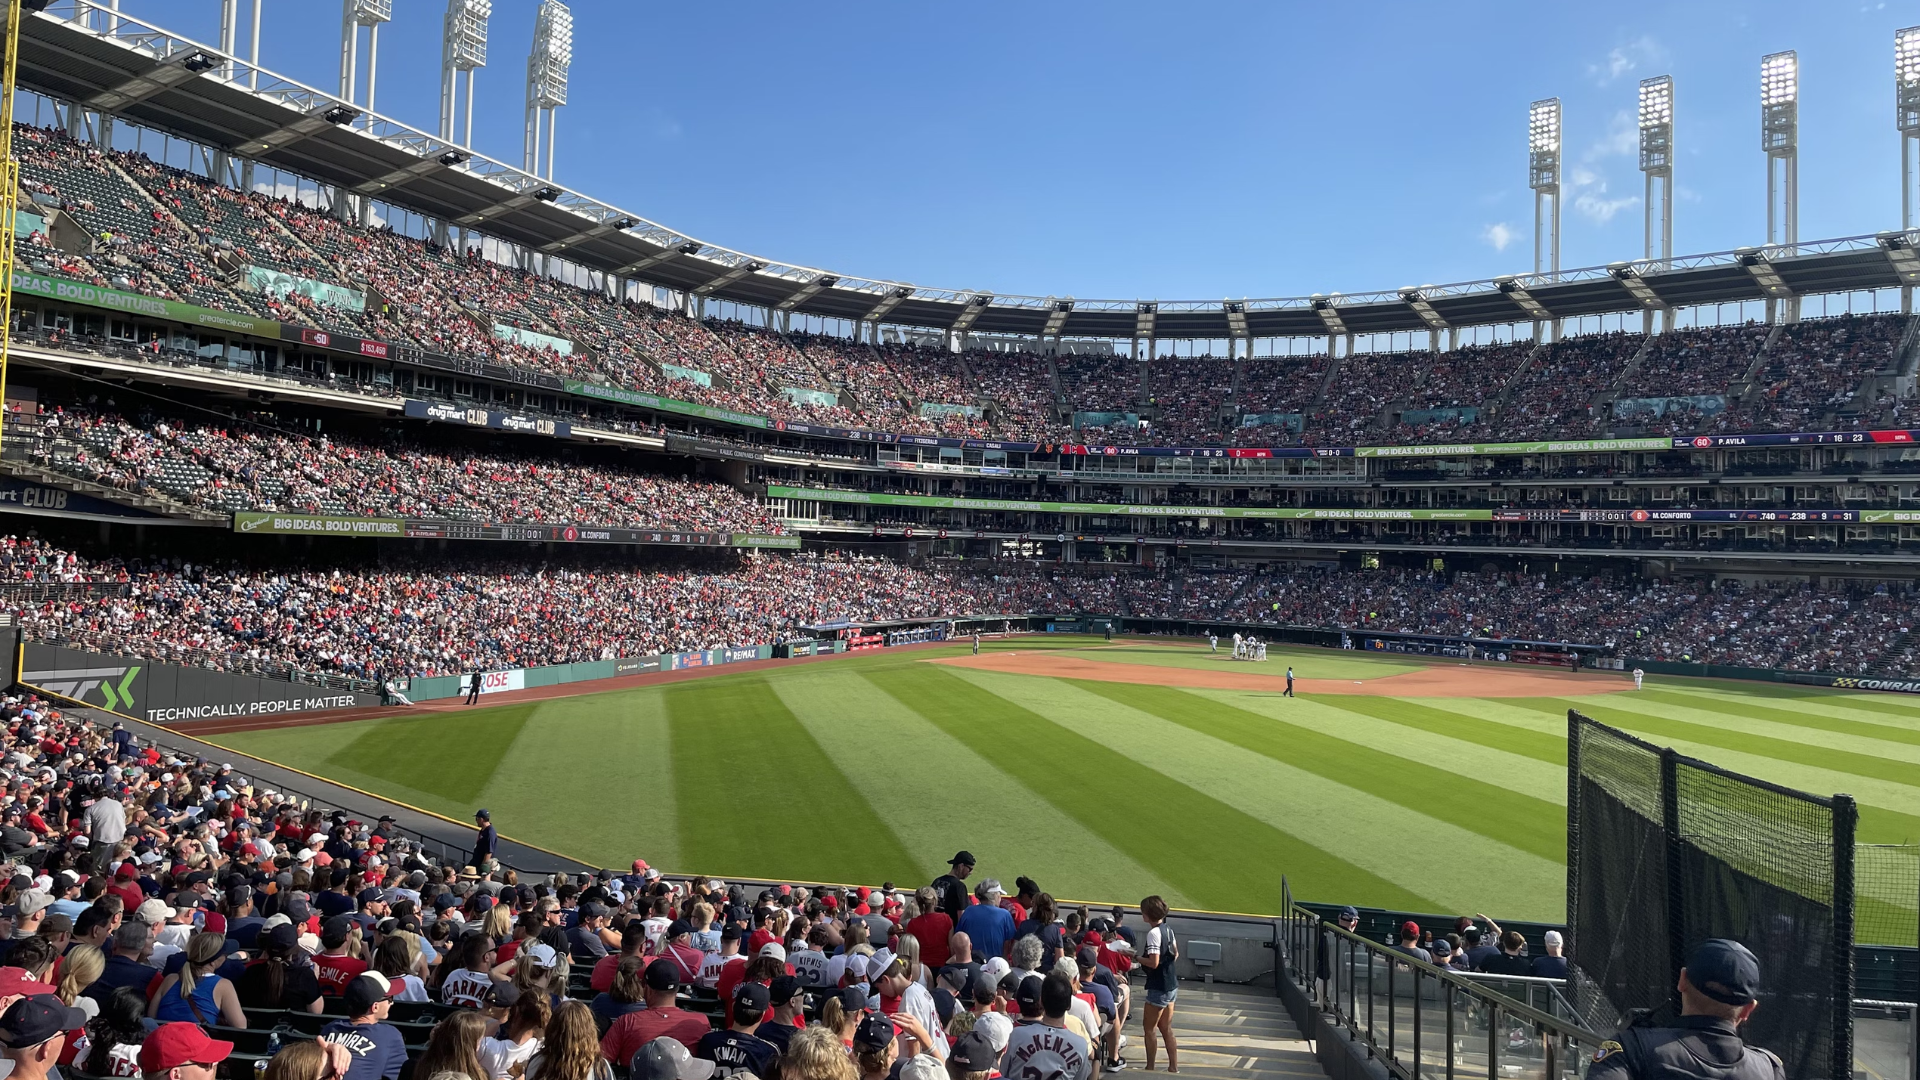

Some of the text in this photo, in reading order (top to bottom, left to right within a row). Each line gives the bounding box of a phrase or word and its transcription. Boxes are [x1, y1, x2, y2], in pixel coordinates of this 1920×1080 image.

[12, 274, 169, 316] DEAS. BOLD VENTURES.
[199, 313, 254, 330] greatercle.com
[583, 384, 595, 395] BIG
[594, 386, 614, 399] IDEAS.
[615, 389, 631, 401] BOLD
[631, 391, 660, 407] VENTURES.
[427, 405, 446, 420] drug
[446, 409, 466, 421] mart
[467, 409, 488, 426] CLUB
[502, 415, 555, 435] drug mart CLUB
[1548, 443, 1561, 451] BIG
[1561, 442, 1592, 450] IDEAS.
[1593, 441, 1611, 450] BOLD
[1612, 439, 1667, 449] VENTURES.
[1697, 438, 1707, 446] 60
[1725, 437, 1746, 445] AVILA
[1834, 435, 1843, 443] 16
[1852, 434, 1863, 442] 23
[1107, 446, 1115, 455] 60
[1203, 449, 1210, 457] 16
[1215, 449, 1223, 457] 23
[1390, 447, 1413, 455] IDEAS.
[1414, 447, 1431, 455] BOLD
[1431, 446, 1476, 454] VENTURES.
[22, 487, 68, 509] CLUB
[953, 500, 1042, 510] BIG IDEAS. BOLD VENTURES.
[1142, 507, 1165, 515] IDEAS.
[1165, 507, 1185, 515] BOLD
[1186, 508, 1226, 516] VENTURES.
[1315, 510, 1328, 518] BIG
[240, 515, 400, 533] Cleveland BIG IDEAS. BOLD VENTURES.
[587, 532, 610, 540] CONFORTO
[733, 648, 756, 661] RE/MAX
[147, 695, 356, 722] TECHNICALLY, PEOPLE MATTER.
[799, 956, 823, 969] KIPNIS
[321, 966, 349, 985] SMILE
[704, 963, 725, 978] RAM
[323, 1030, 377, 1057] AMÍREZ
[713, 1046, 747, 1064] KWAN
[1015, 1033, 1083, 1070] McKENZIE
